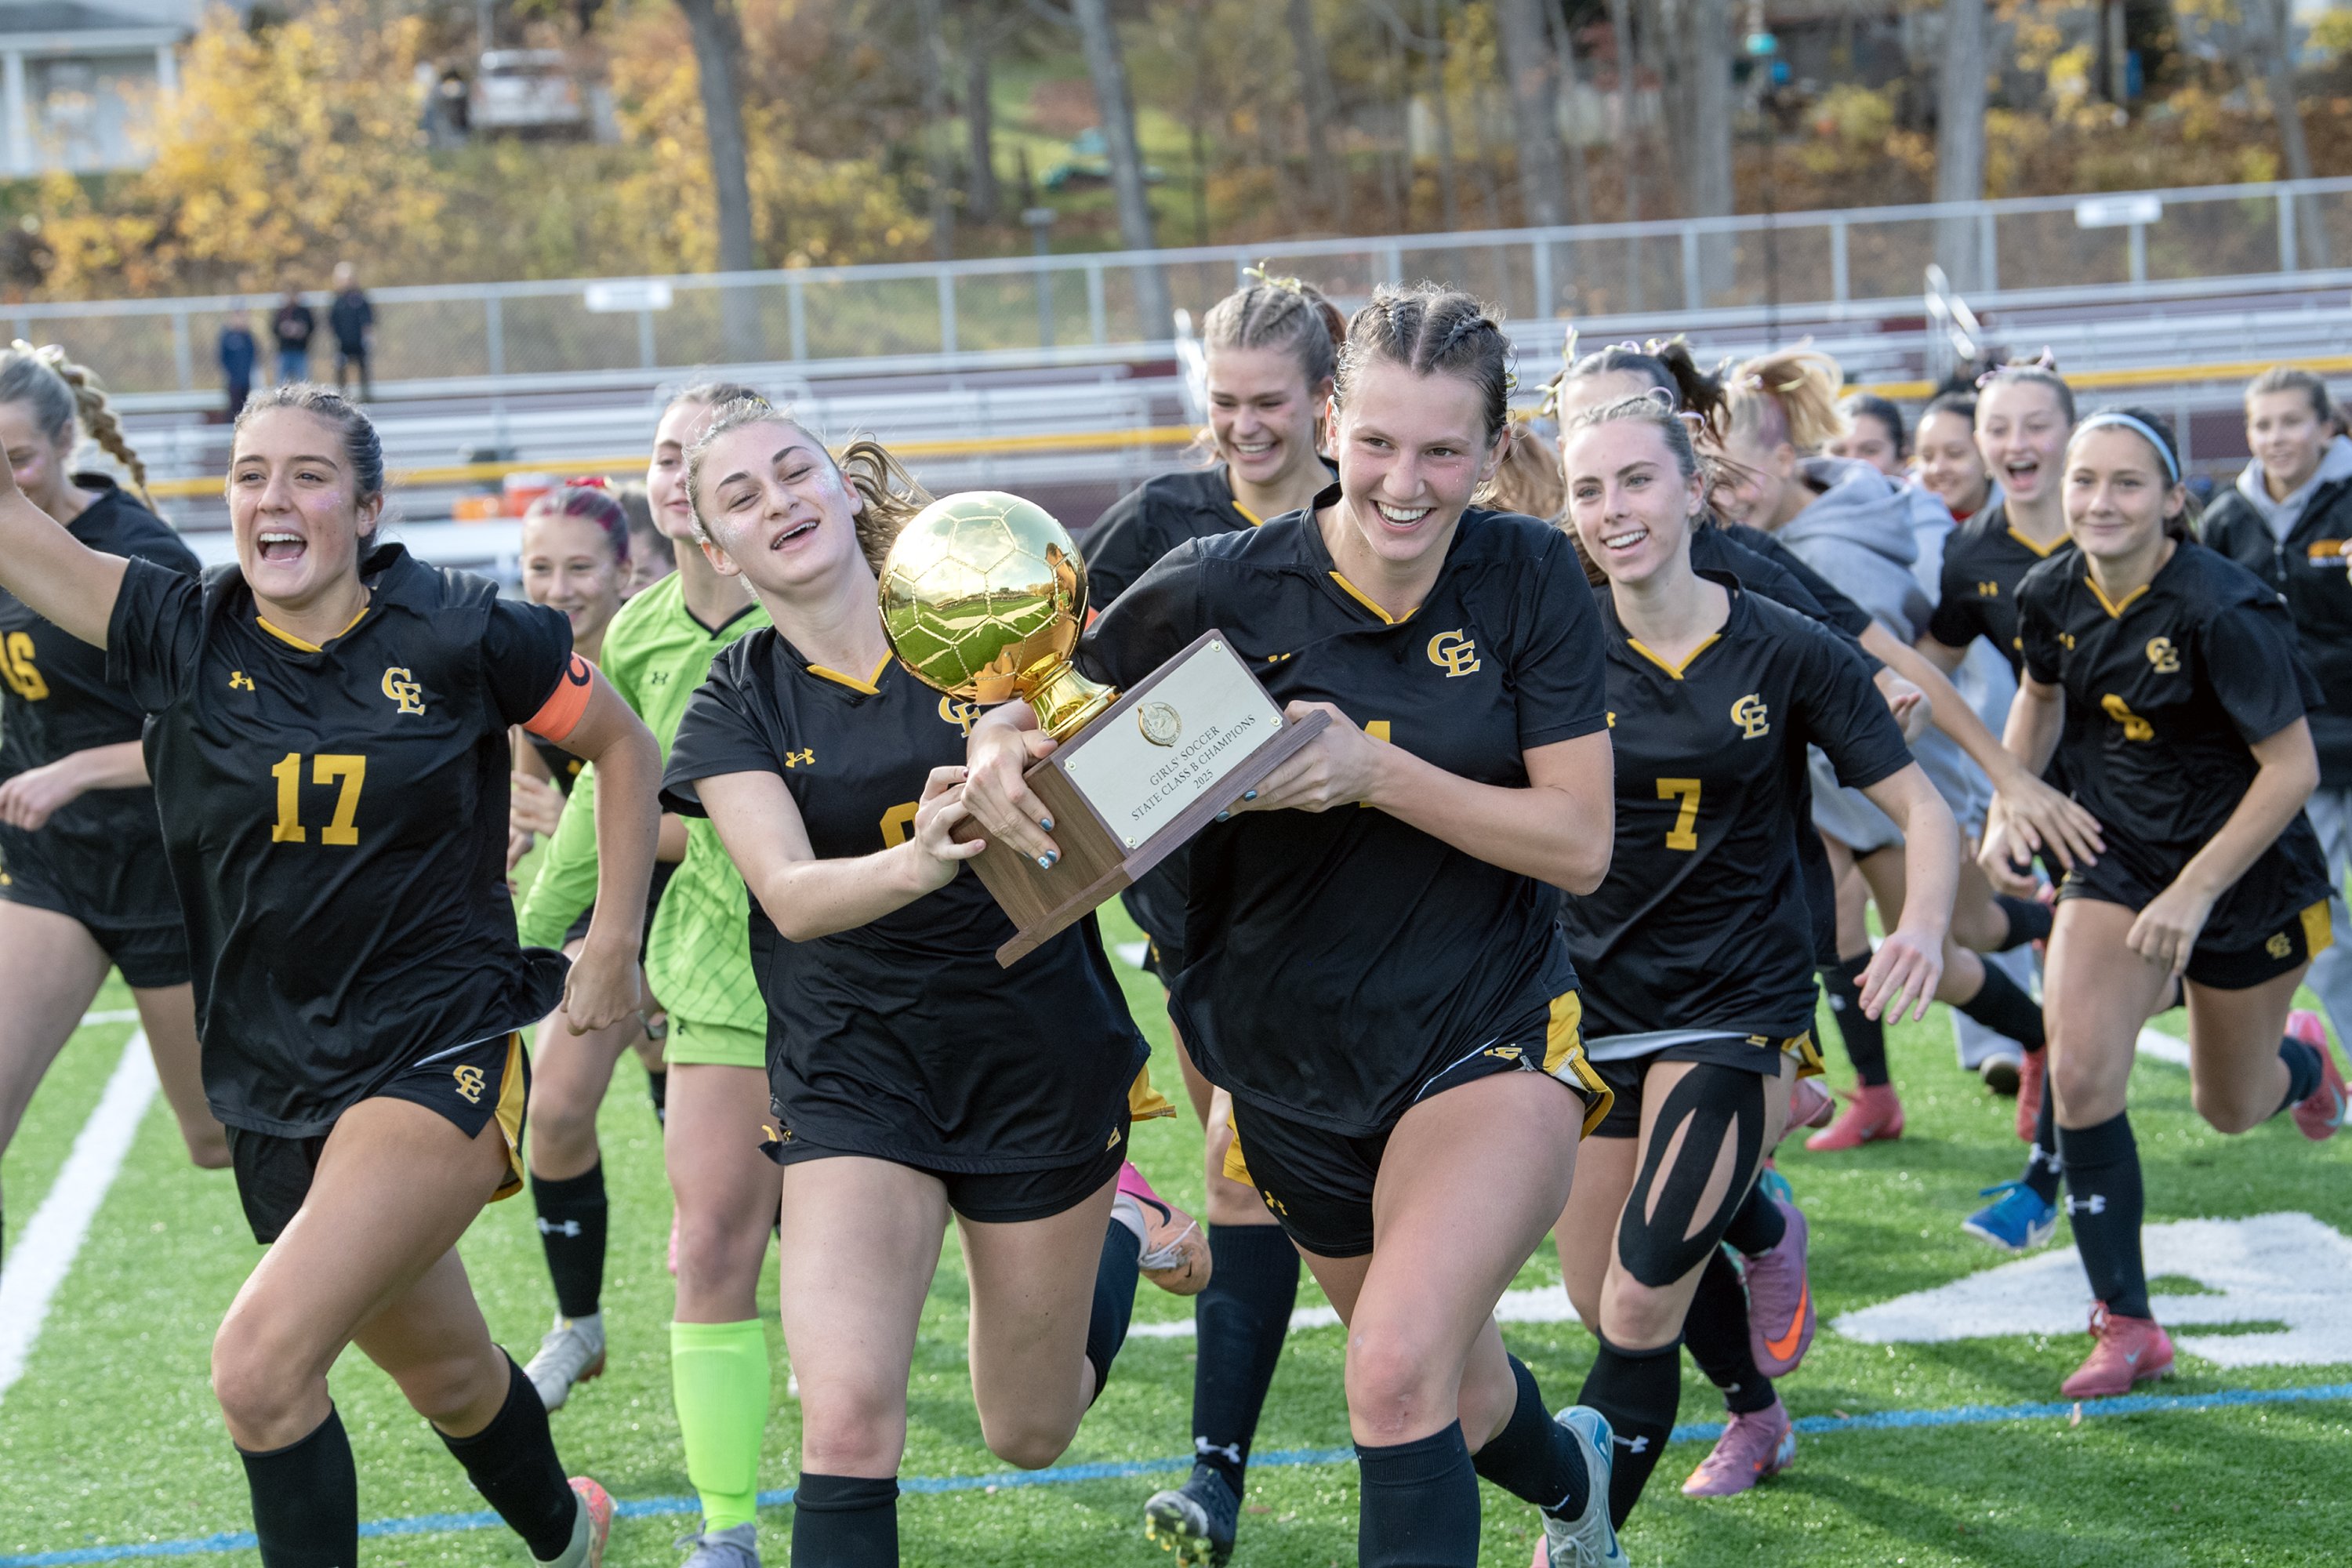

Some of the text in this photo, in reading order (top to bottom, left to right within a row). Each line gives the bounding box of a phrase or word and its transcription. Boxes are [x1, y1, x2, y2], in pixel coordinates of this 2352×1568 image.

[1427, 628, 1481, 677] CE
[381, 667, 426, 716] CE
[1730, 693, 1770, 740] CE
[1131, 792, 1163, 821] STATE
[1161, 768, 1192, 796] CLASS
[1191, 761, 1200, 772] B
[1198, 713, 1256, 766] CHAMPIONS
[1149, 725, 1220, 786] GIRLS' SOCCER
[1193, 769, 1214, 789] 2025
[272, 753, 366, 845] 17
[1656, 778, 1701, 851] 7
